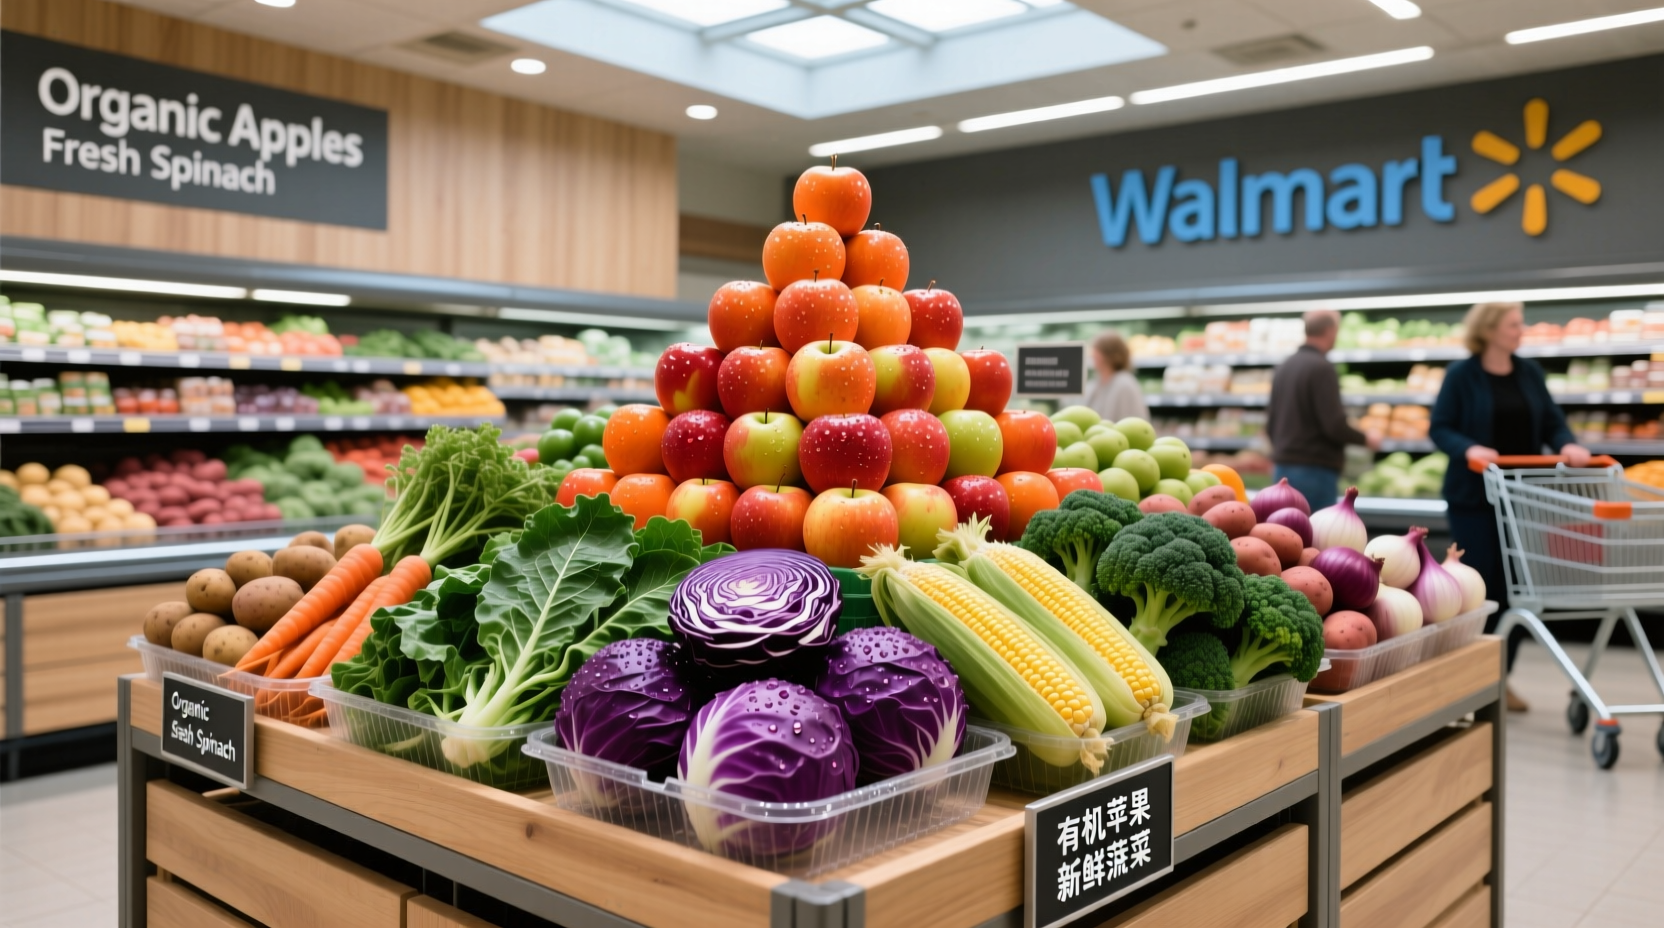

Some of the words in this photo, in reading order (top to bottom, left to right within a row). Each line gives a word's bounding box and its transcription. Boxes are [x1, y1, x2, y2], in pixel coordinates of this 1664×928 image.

[38, 67, 222, 143] Organic
[228, 104, 363, 167] Apples
[43, 127, 141, 176] Fresh
[150, 145, 276, 195] Spinach
[1090, 135, 1457, 247] Walmart
[196, 728, 236, 762] Spinach
[1057, 787, 1151, 856] 有机苹果
